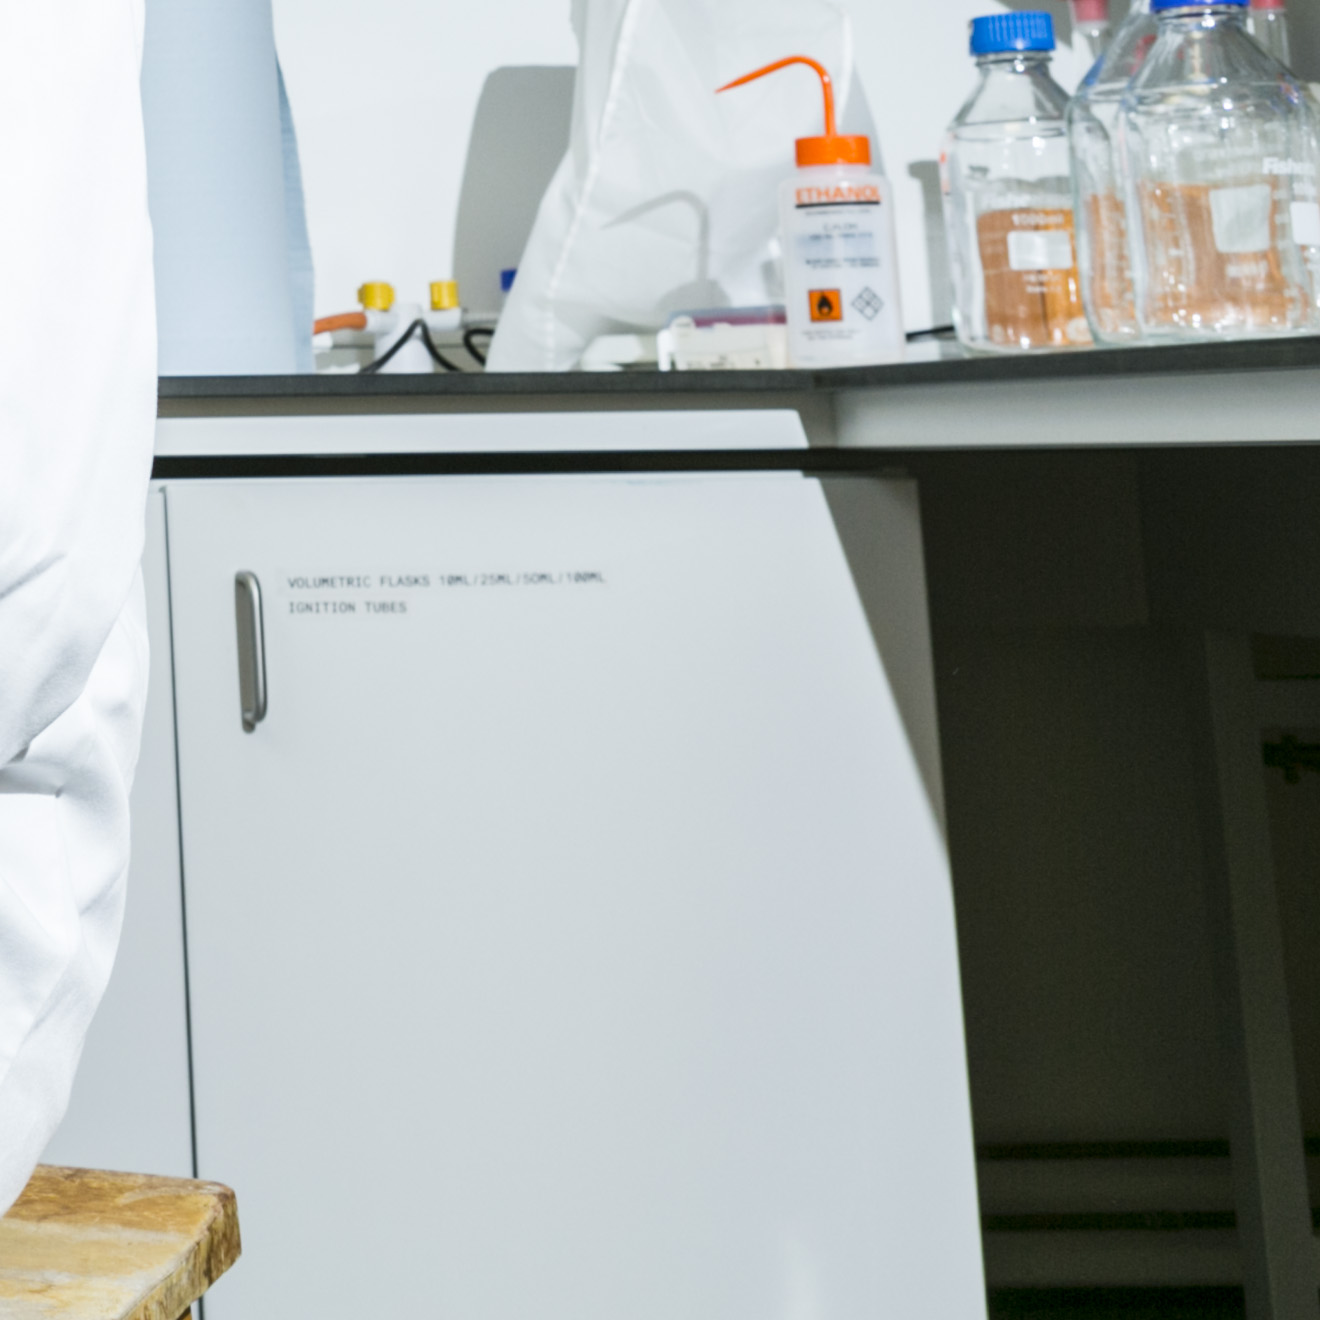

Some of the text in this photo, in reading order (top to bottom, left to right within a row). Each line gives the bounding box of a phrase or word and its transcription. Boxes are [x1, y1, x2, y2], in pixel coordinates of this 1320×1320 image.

[794, 184, 882, 205] ETHANOL
[287, 575, 372, 589] VOLUMETRIC
[379, 574, 431, 588] FLASKS
[288, 600, 408, 615] IGNITION TUBES
